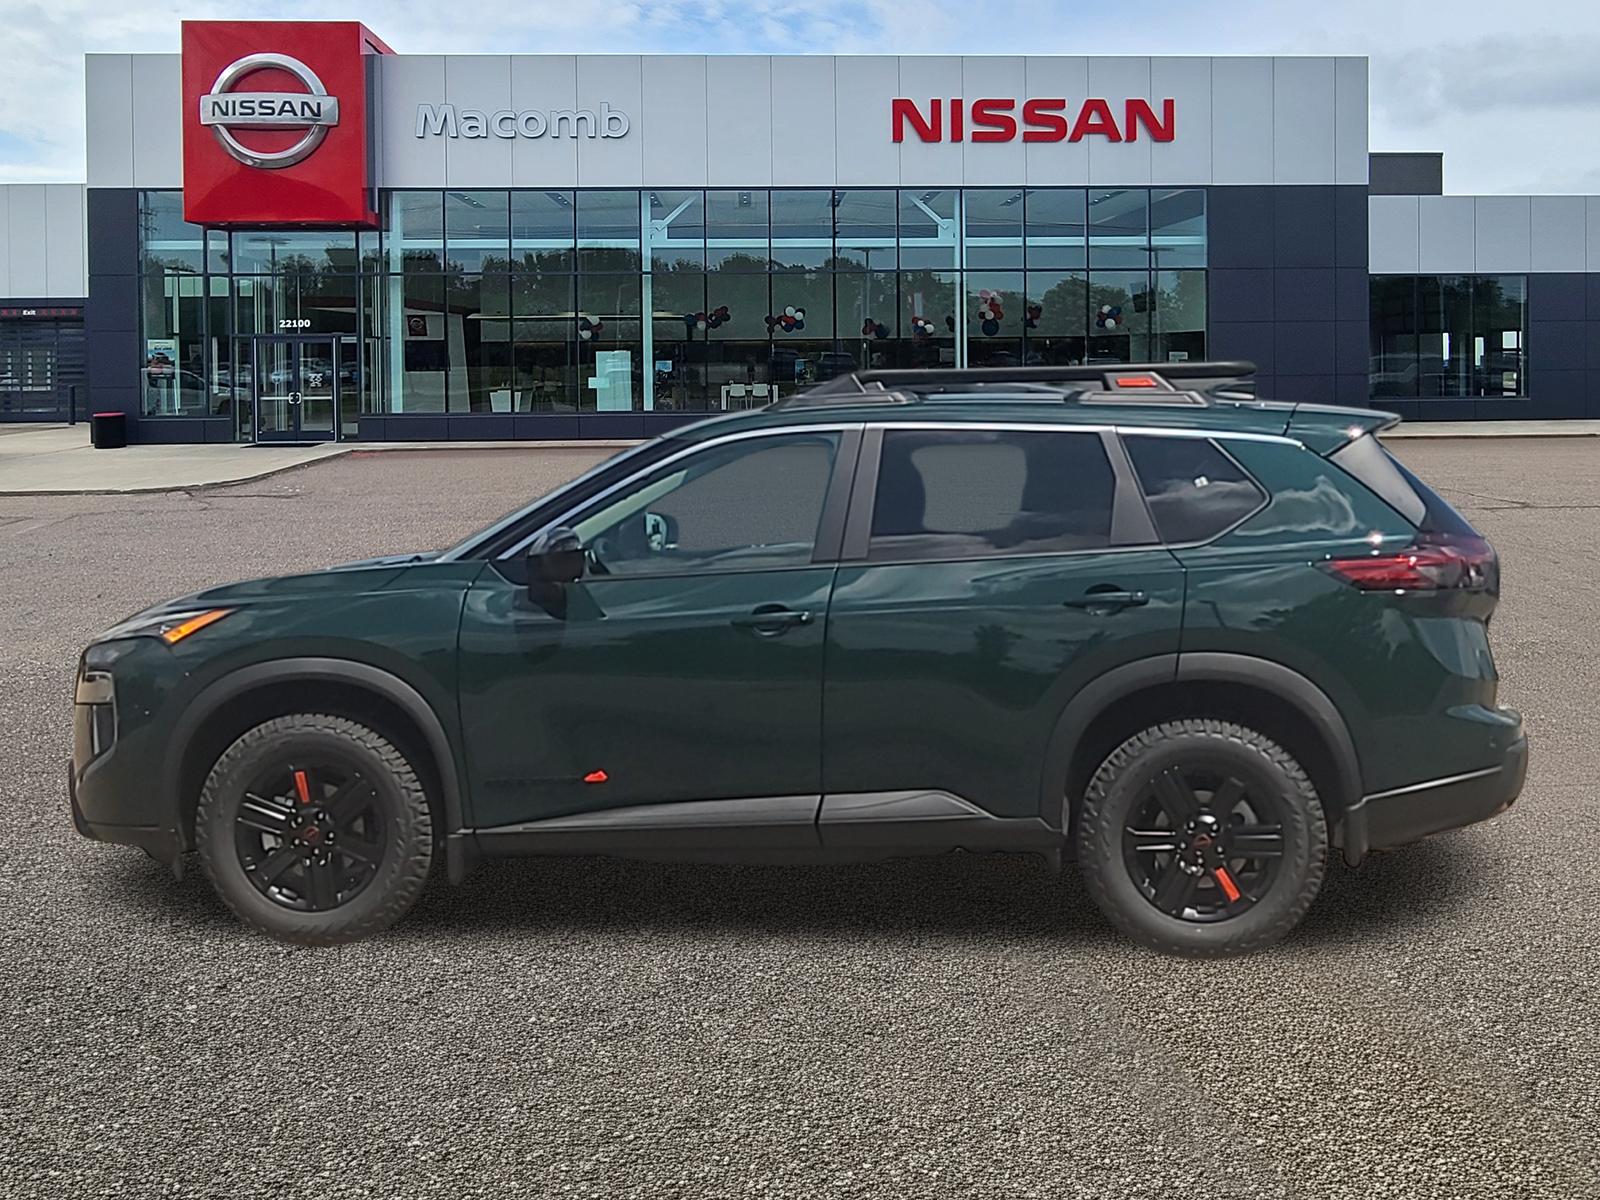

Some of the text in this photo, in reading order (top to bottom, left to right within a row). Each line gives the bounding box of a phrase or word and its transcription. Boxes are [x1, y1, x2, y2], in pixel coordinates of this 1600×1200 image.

[211, 100, 322, 118] NISSAN
[415, 101, 630, 138] Macomb
[892, 98, 1175, 143] NISSAN
[279, 319, 311, 328] 22100
